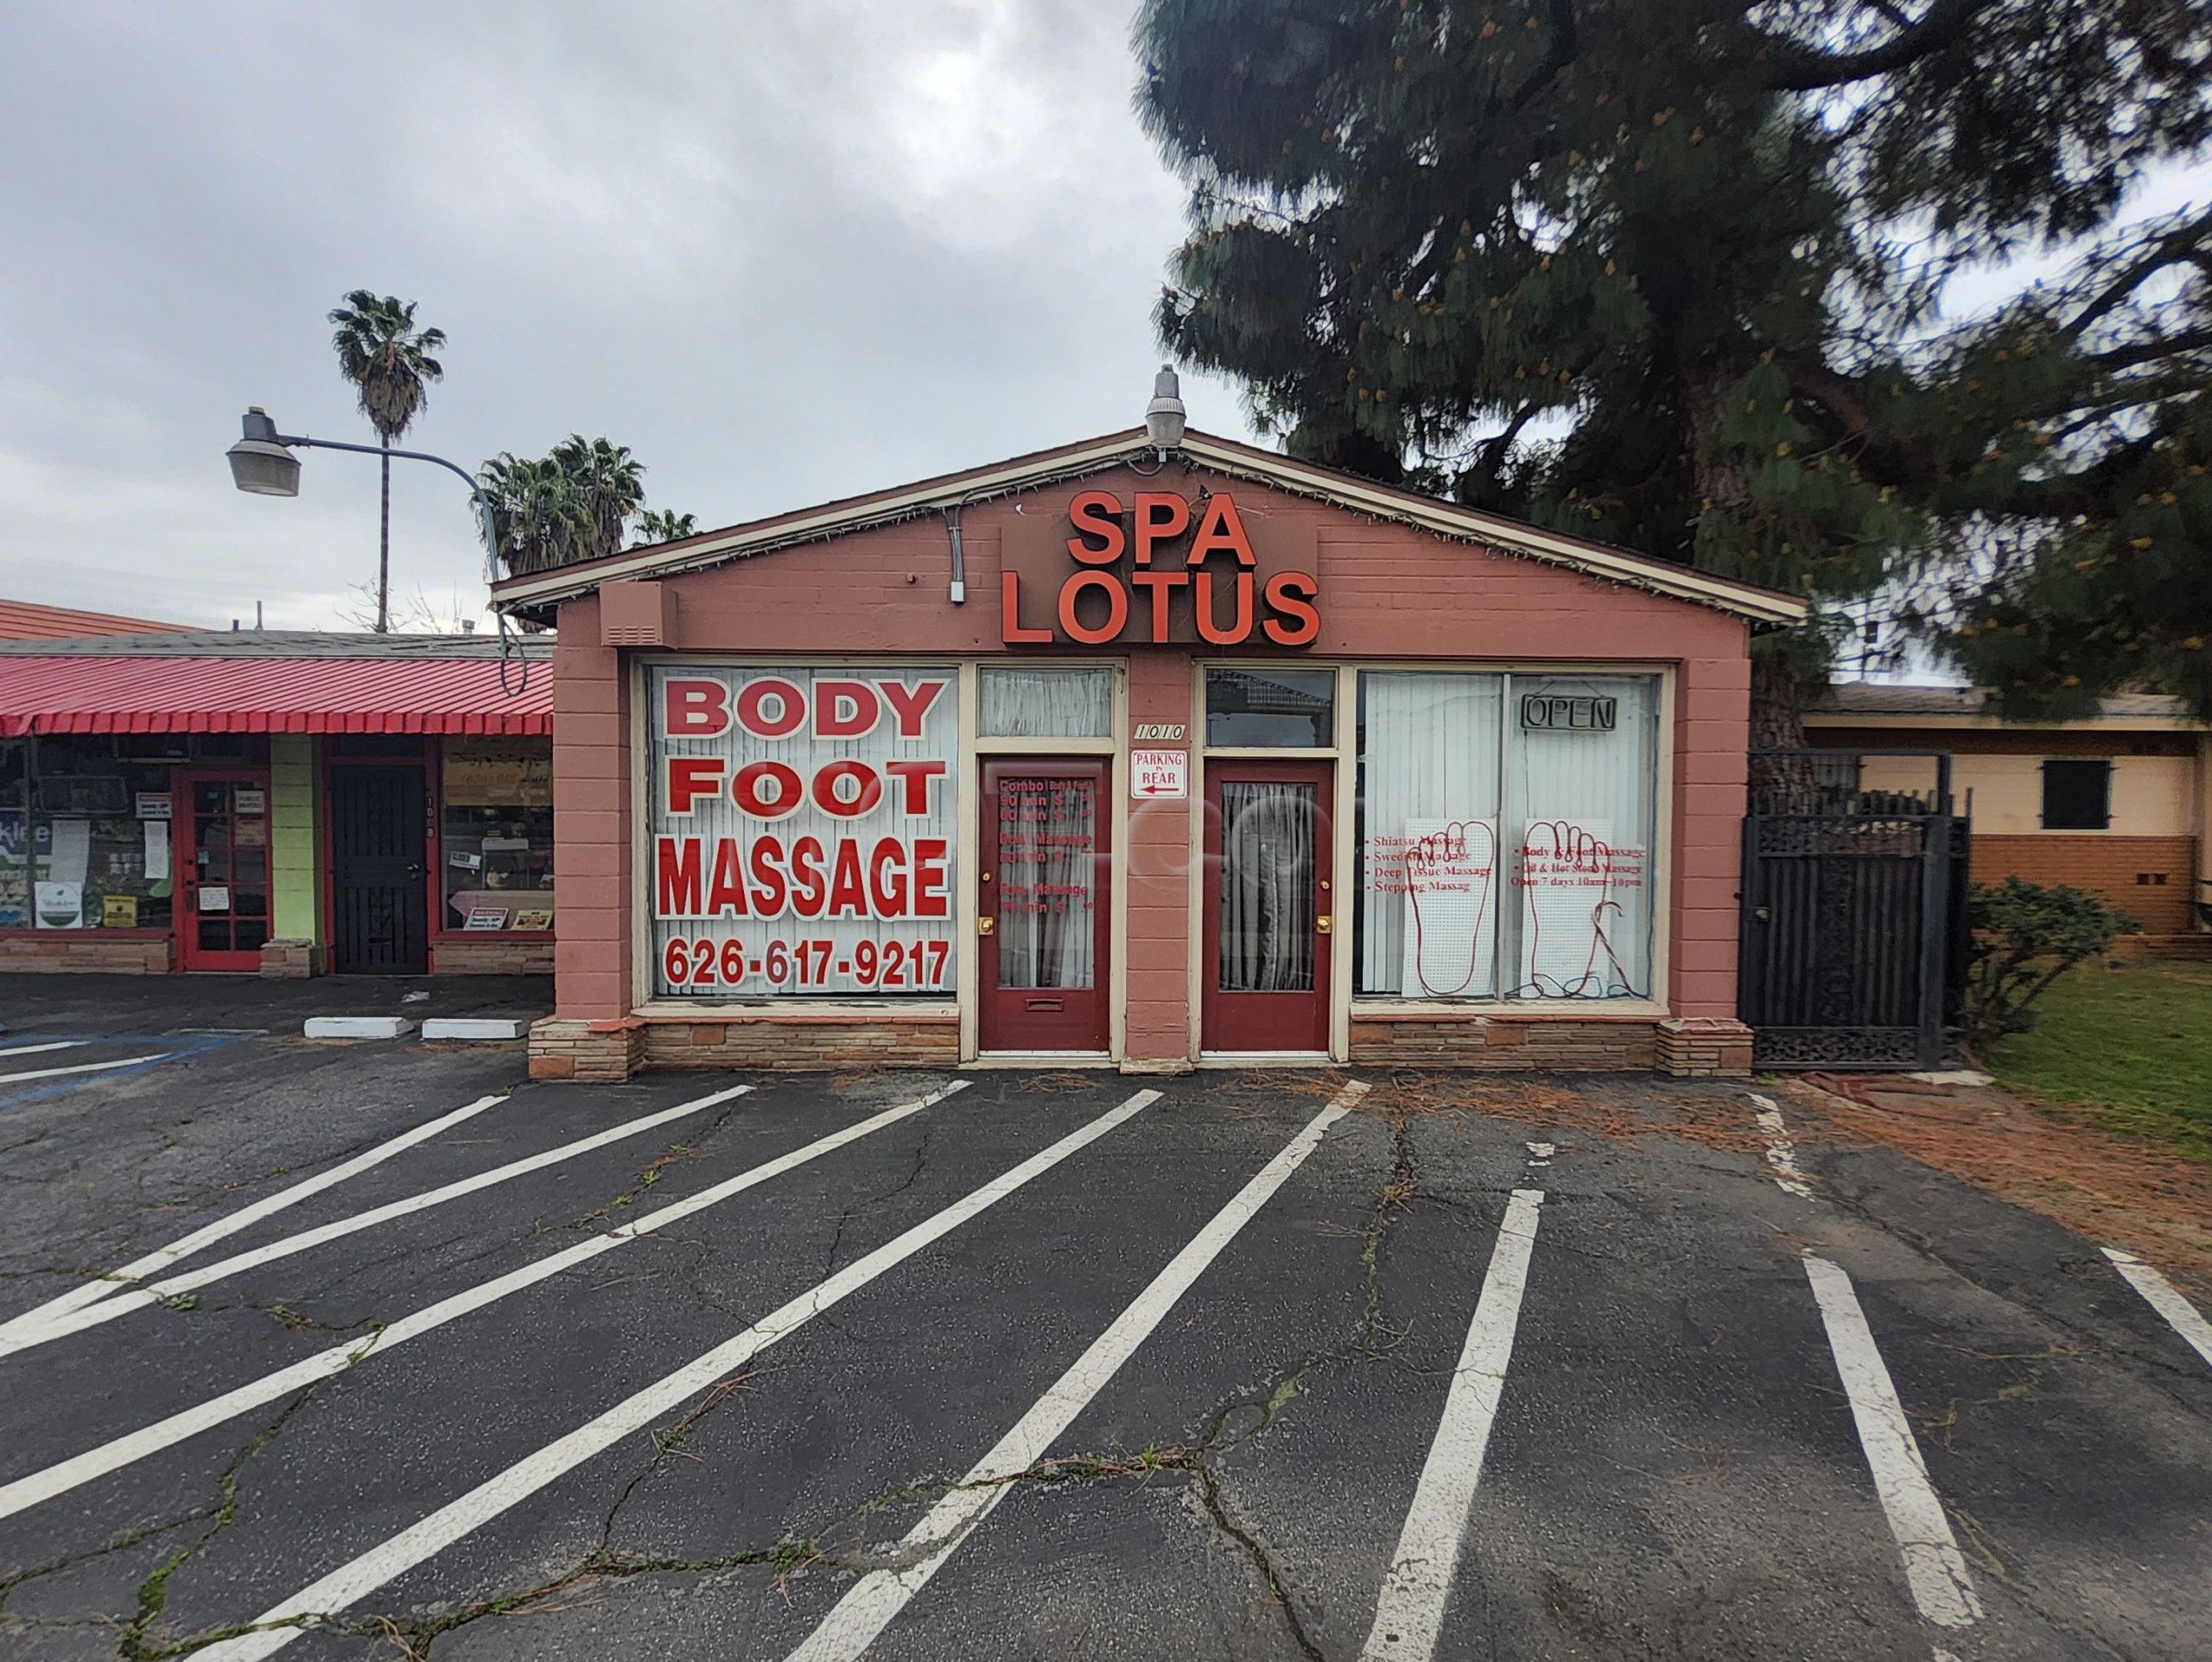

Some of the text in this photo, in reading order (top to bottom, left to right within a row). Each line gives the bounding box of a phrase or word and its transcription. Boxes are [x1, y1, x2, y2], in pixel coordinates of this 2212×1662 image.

[1066, 489, 1257, 568] SPA
[1001, 570, 1321, 646] LOTUS
[664, 677, 951, 741] BODY
[1526, 698, 1612, 729] OPEN
[1138, 725, 1183, 739] 1010
[1136, 754, 1182, 766] PARKING
[1142, 772, 1176, 784] REAR
[665, 755, 950, 822] FOOT
[1000, 780, 1044, 792] Combo
[1054, 793, 1064, 806] $
[1036, 831, 1092, 846] Massage
[1374, 836, 1414, 846] Shiatsu
[1375, 867, 1402, 879] Deep
[1445, 867, 1492, 880] Massage
[1539, 863, 1548, 873] &
[655, 833, 950, 921] MASSAGE
[1541, 876, 1548, 886] 7
[1550, 876, 1574, 888] days
[1033, 882, 1089, 897] Massage
[663, 935, 951, 989] 626-617-9217
